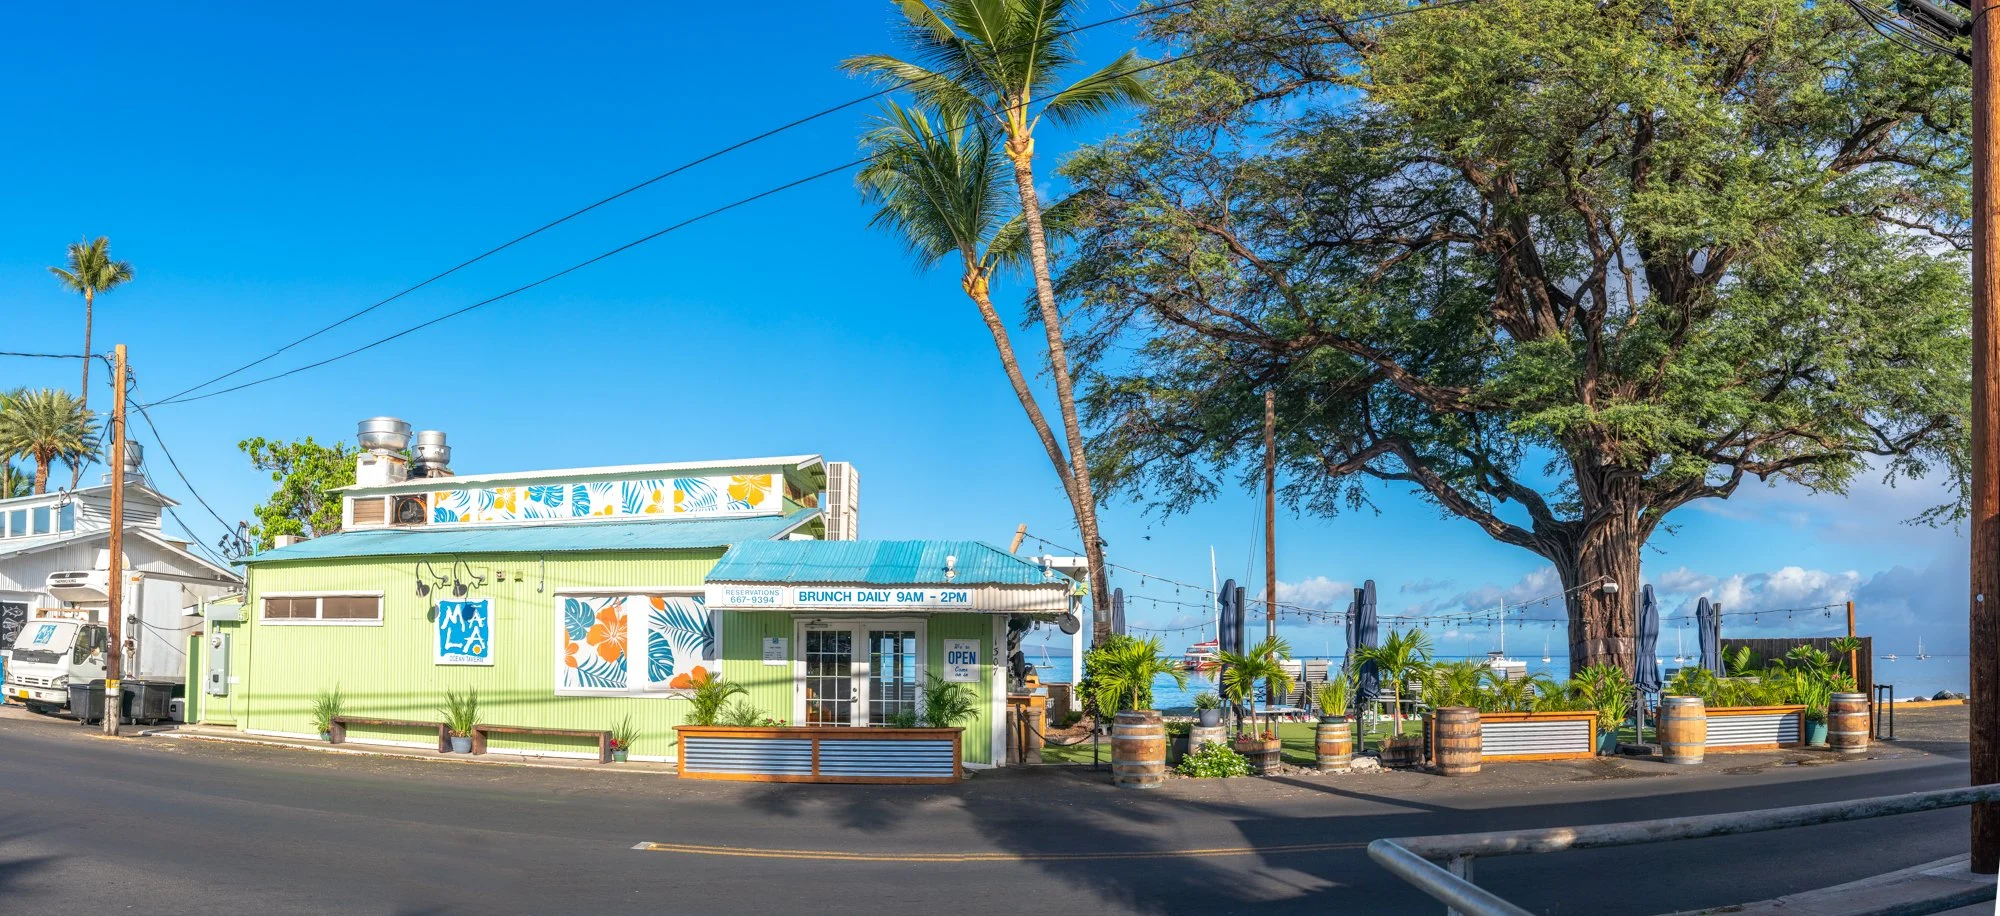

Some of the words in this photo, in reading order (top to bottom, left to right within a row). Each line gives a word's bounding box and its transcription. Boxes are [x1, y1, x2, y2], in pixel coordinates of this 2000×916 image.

[730, 596, 775, 604] 667-9394
[799, 591, 852, 602] BRUNCH
[857, 592, 892, 602] DAILY
[896, 592, 924, 603] 9AM
[940, 592, 967, 603] 2PM
[948, 651, 976, 665] OPEN
